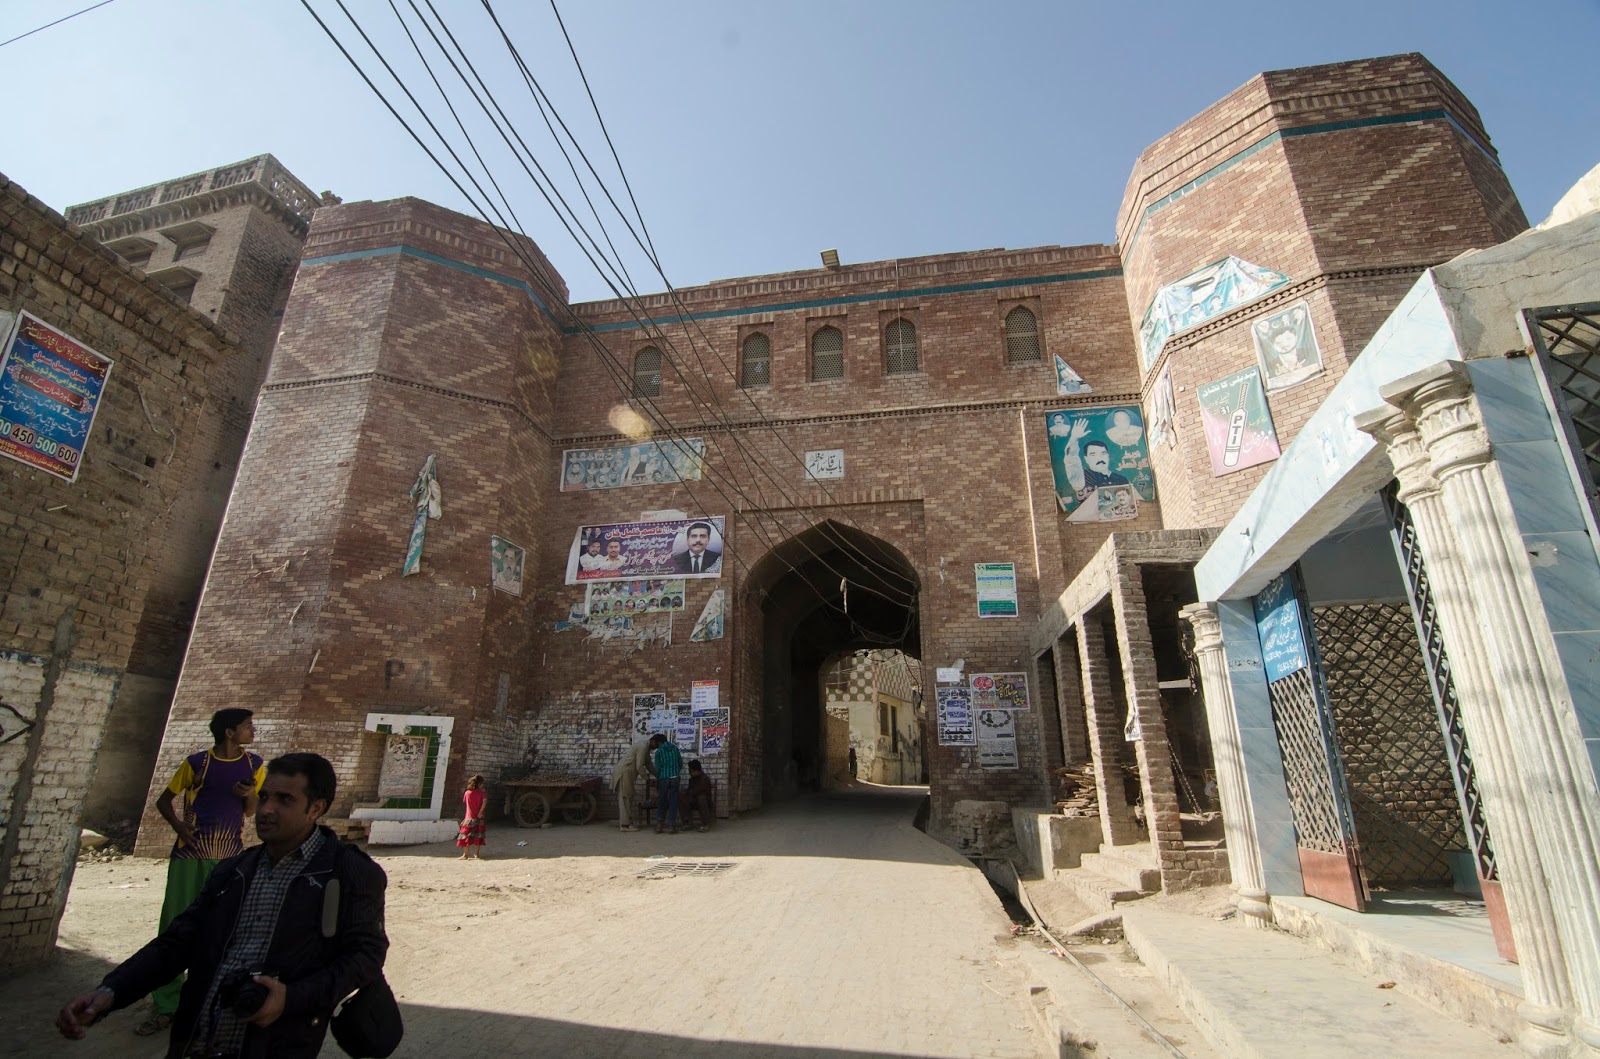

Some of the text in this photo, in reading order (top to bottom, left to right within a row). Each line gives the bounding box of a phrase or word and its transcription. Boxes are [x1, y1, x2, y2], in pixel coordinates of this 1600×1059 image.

[33, 351, 87, 383] سیل سیل سیل
[1220, 380, 1229, 389] کا
[44, 386, 64, 398] رمضان
[1220, 406, 1230, 415] 31
[1231, 415, 1243, 445] PTI
[12, 427, 34, 445] 450
[35, 436, 57, 455] 500
[58, 446, 78, 464] 600
[604, 528, 620, 540] خان
